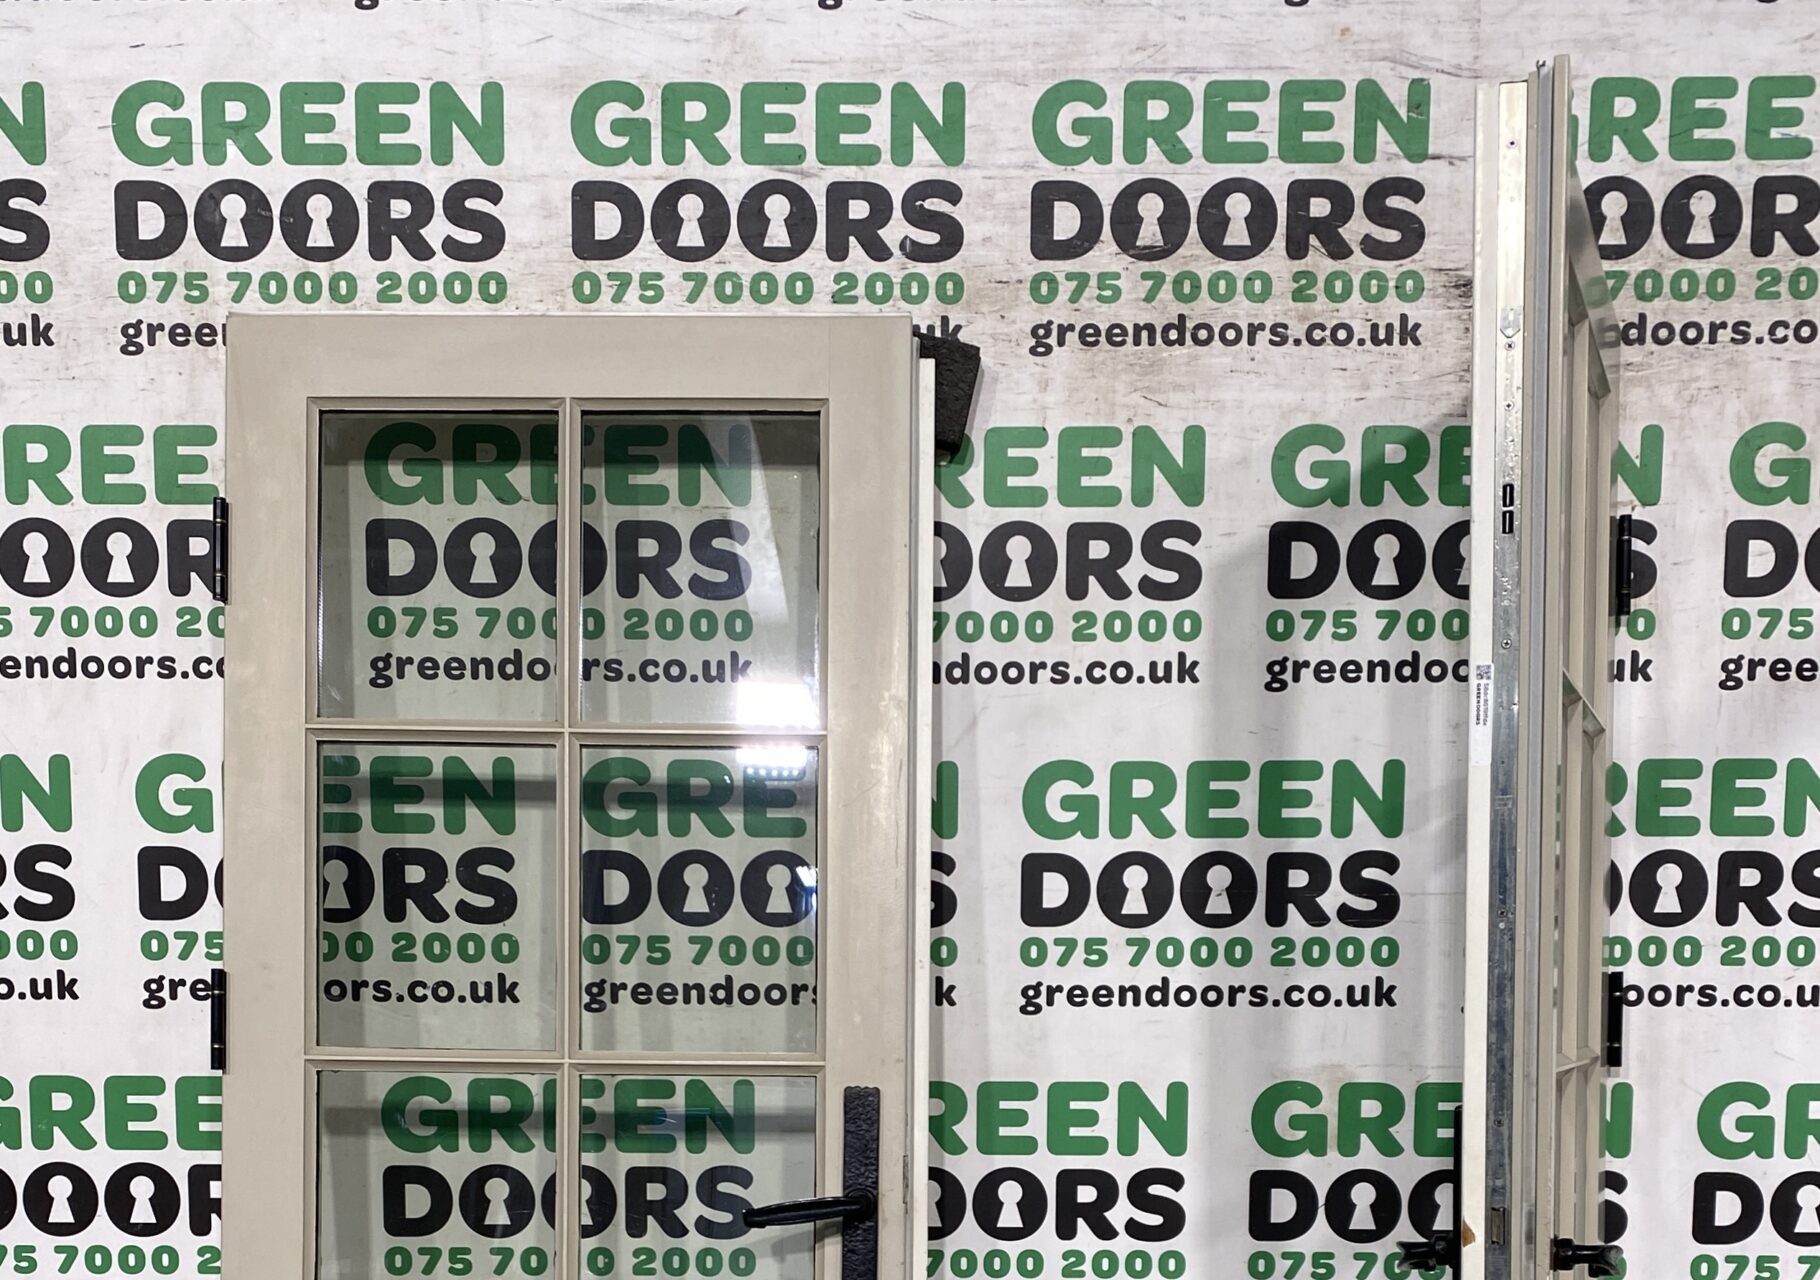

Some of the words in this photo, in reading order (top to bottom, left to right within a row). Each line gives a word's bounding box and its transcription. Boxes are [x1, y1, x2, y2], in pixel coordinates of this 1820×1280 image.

[111, 80, 504, 166] GREEN
[570, 80, 965, 167] GREEN
[1032, 78, 1431, 165] GREEN
[1571, 75, 1817, 163] REE
[114, 178, 506, 262] DOORS
[571, 178, 964, 262] DOORS
[1029, 176, 1426, 261] DOORS
[117, 270, 209, 304] 075
[227, 270, 358, 304] 7000
[376, 270, 508, 304] 2000
[572, 270, 665, 304] 075
[681, 271, 815, 304] 7000
[832, 271, 965, 304] 2000
[1029, 269, 1122, 303] 075
[1141, 270, 1273, 303] 7000
[1291, 269, 1424, 303] 2000
[1605, 268, 1736, 302] 7000
[1029, 312, 1423, 357] greendoors.co.uk
[365, 517, 753, 601] DOORS
[30, 606, 158, 638] 7000
[367, 605, 459, 639] 075
[623, 608, 753, 641] 2000
[934, 610, 1054, 643] 7000
[1071, 610, 1202, 643] 2000
[1265, 609, 1357, 642] 075
[1721, 607, 1814, 640] 075
[0, 647, 225, 681] endoors.c
[369, 648, 753, 689] greendors.co.uk
[1022, 759, 1406, 840] GREEN
[1020, 850, 1401, 929] DOORS
[140, 930, 223, 961] 075
[391, 931, 520, 964] 2000
[582, 935, 671, 966] 075
[687, 935, 814, 968] 7000
[1019, 937, 1109, 968] 075
[1126, 937, 1253, 968] 7000
[1270, 936, 1400, 968] 2000
[1018, 976, 1398, 1016] greendoors.co.uk
[0, 1075, 222, 1151] REE
[382, 1163, 754, 1240] DOORS
[54, 1245, 180, 1275] 7000
[383, 1246, 473, 1276] 075
[489, 1246, 615, 1277] 700
[632, 1246, 756, 1277] 2000
[927, 1249, 1045, 1280] 7000
[1061, 1249, 1187, 1280] 2000
[1247, 1251, 1336, 1280] 075
